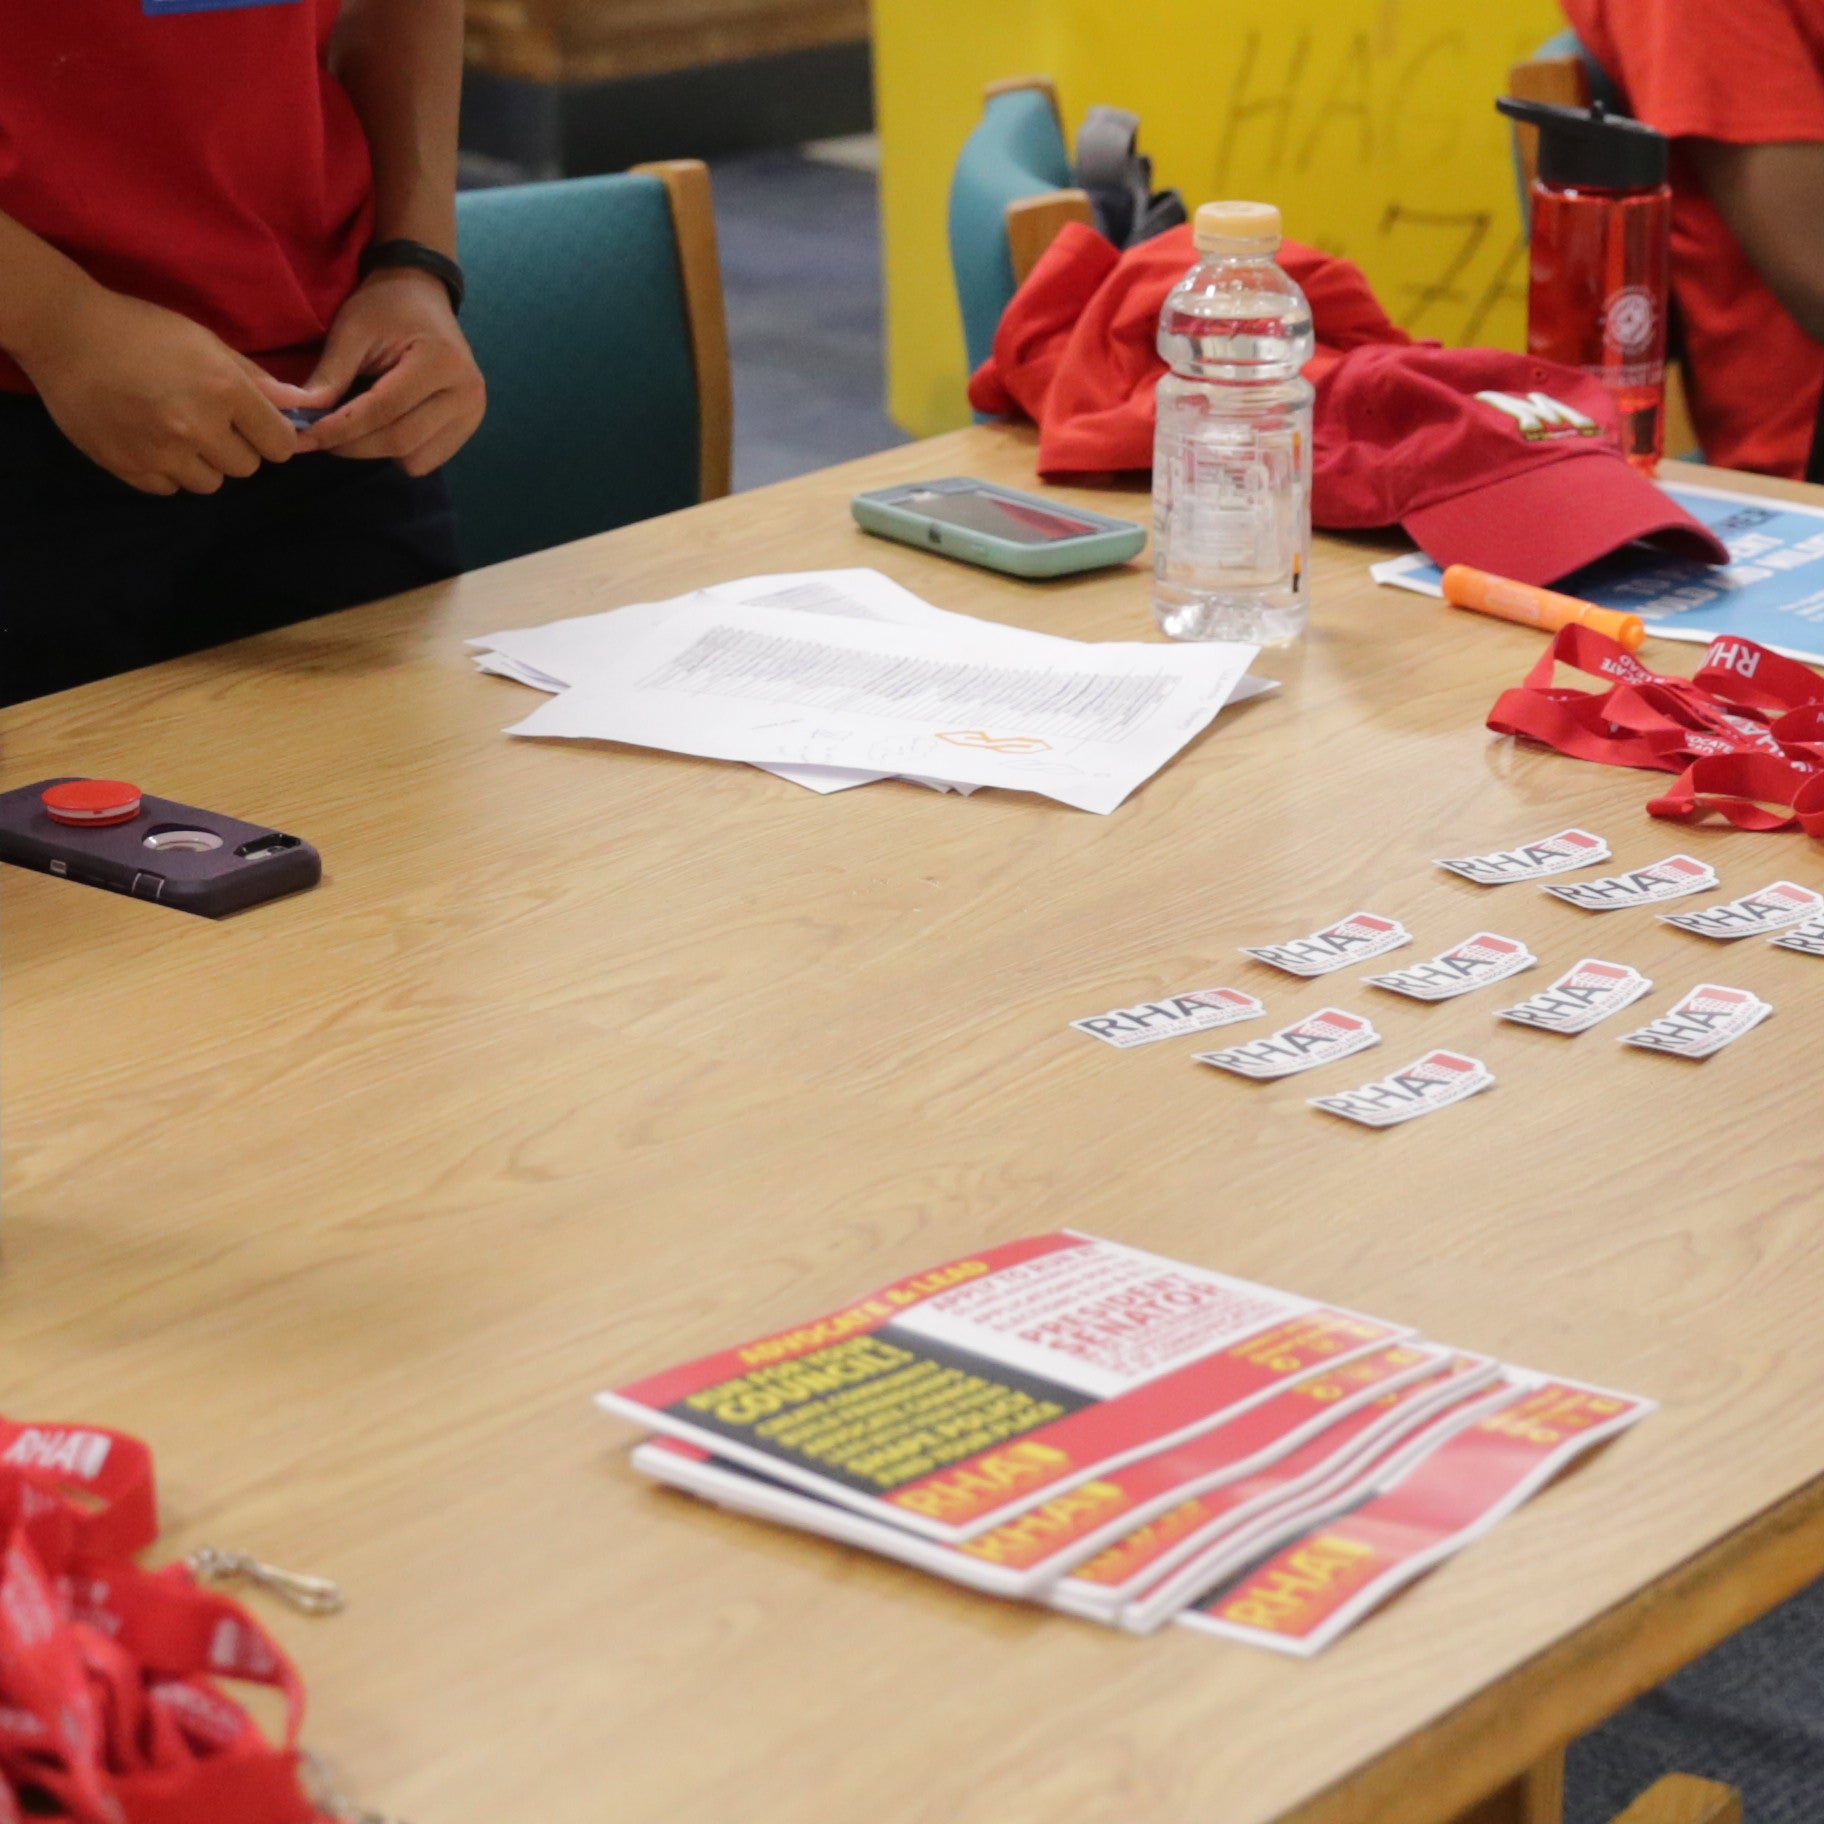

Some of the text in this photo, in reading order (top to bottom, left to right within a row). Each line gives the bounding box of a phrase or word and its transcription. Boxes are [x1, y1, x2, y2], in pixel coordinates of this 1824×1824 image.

[1440, 845, 1572, 875] RHA
[1544, 873, 1679, 902] RHA
[1668, 900, 1791, 930] RHA
[1245, 933, 1373, 966] RHA
[1375, 956, 1498, 991] RHA
[1078, 997, 1221, 1038] RHA
[1502, 984, 1614, 1026] RHA
[1626, 1009, 1734, 1049] RHA
[1204, 1030, 1338, 1070] RHA
[1319, 1075, 1453, 1116] RHA
